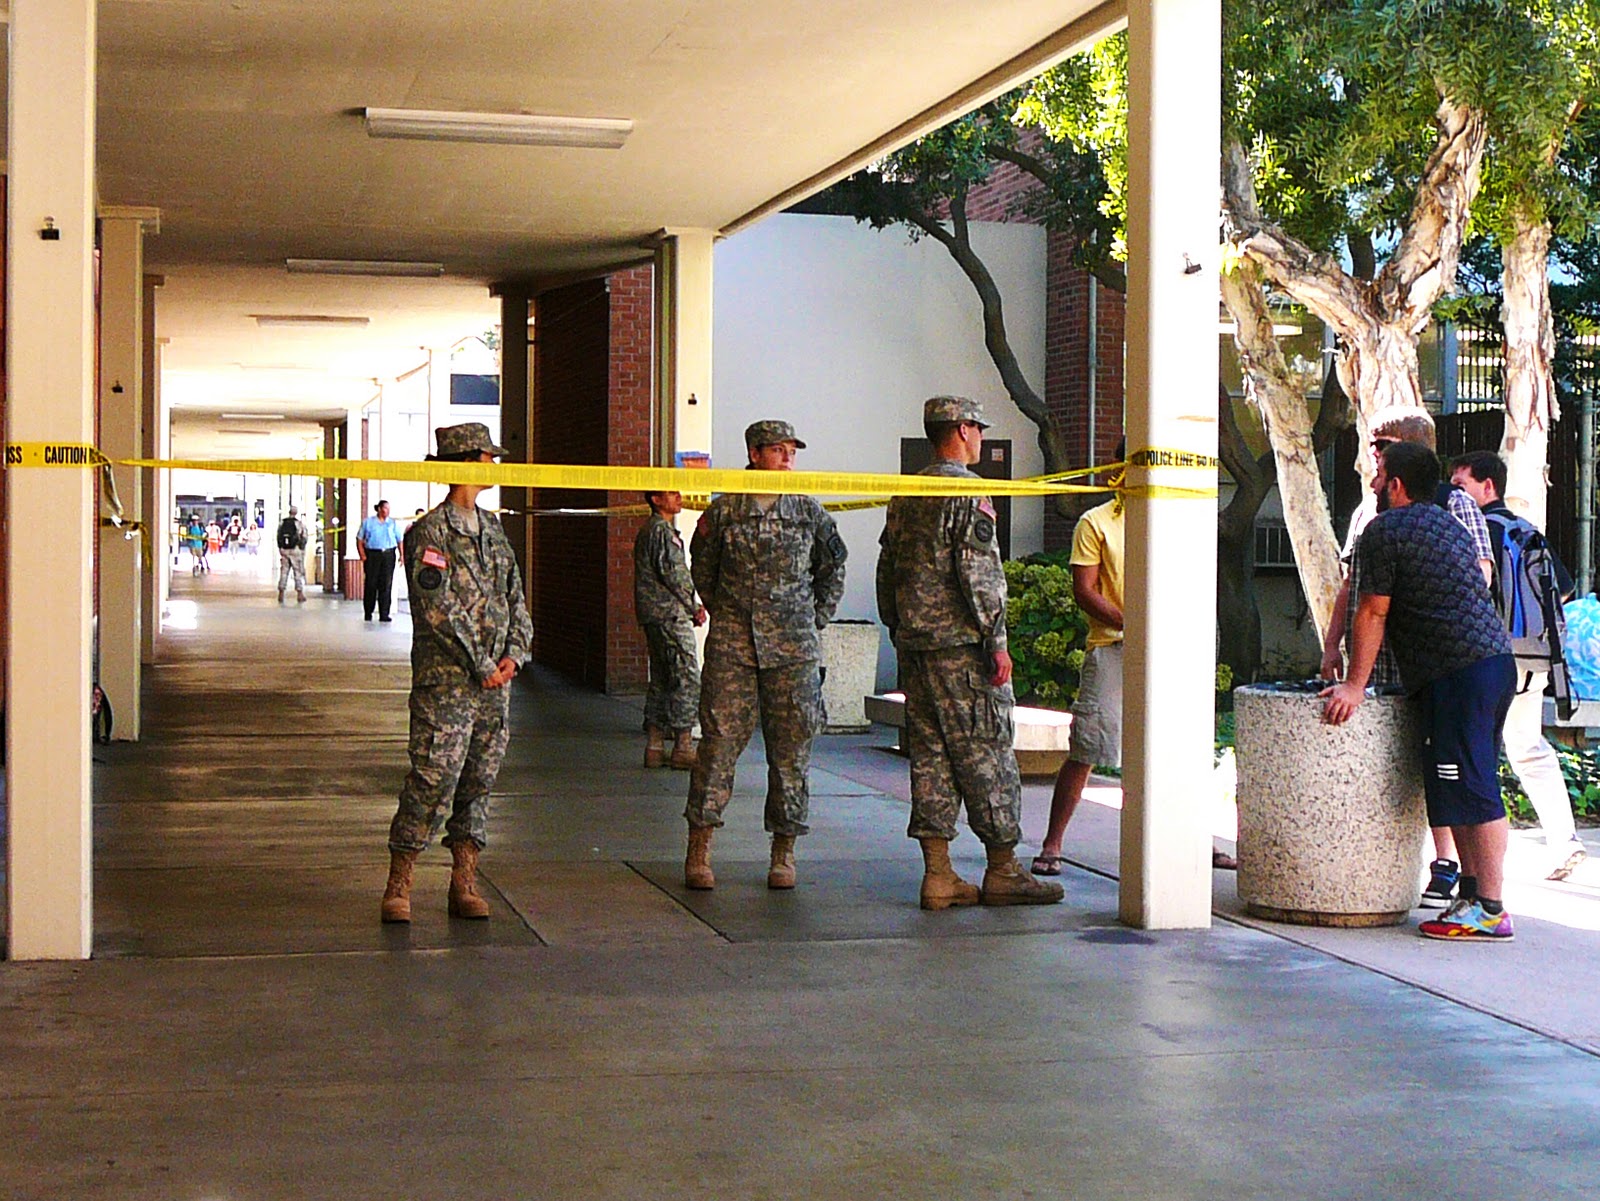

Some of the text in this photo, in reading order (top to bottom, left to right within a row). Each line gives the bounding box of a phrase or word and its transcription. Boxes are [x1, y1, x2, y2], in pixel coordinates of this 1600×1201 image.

[45, 446, 87, 464] CAUTION
[1146, 450, 1173, 466] POLICE
[1175, 453, 1193, 467] LINE
